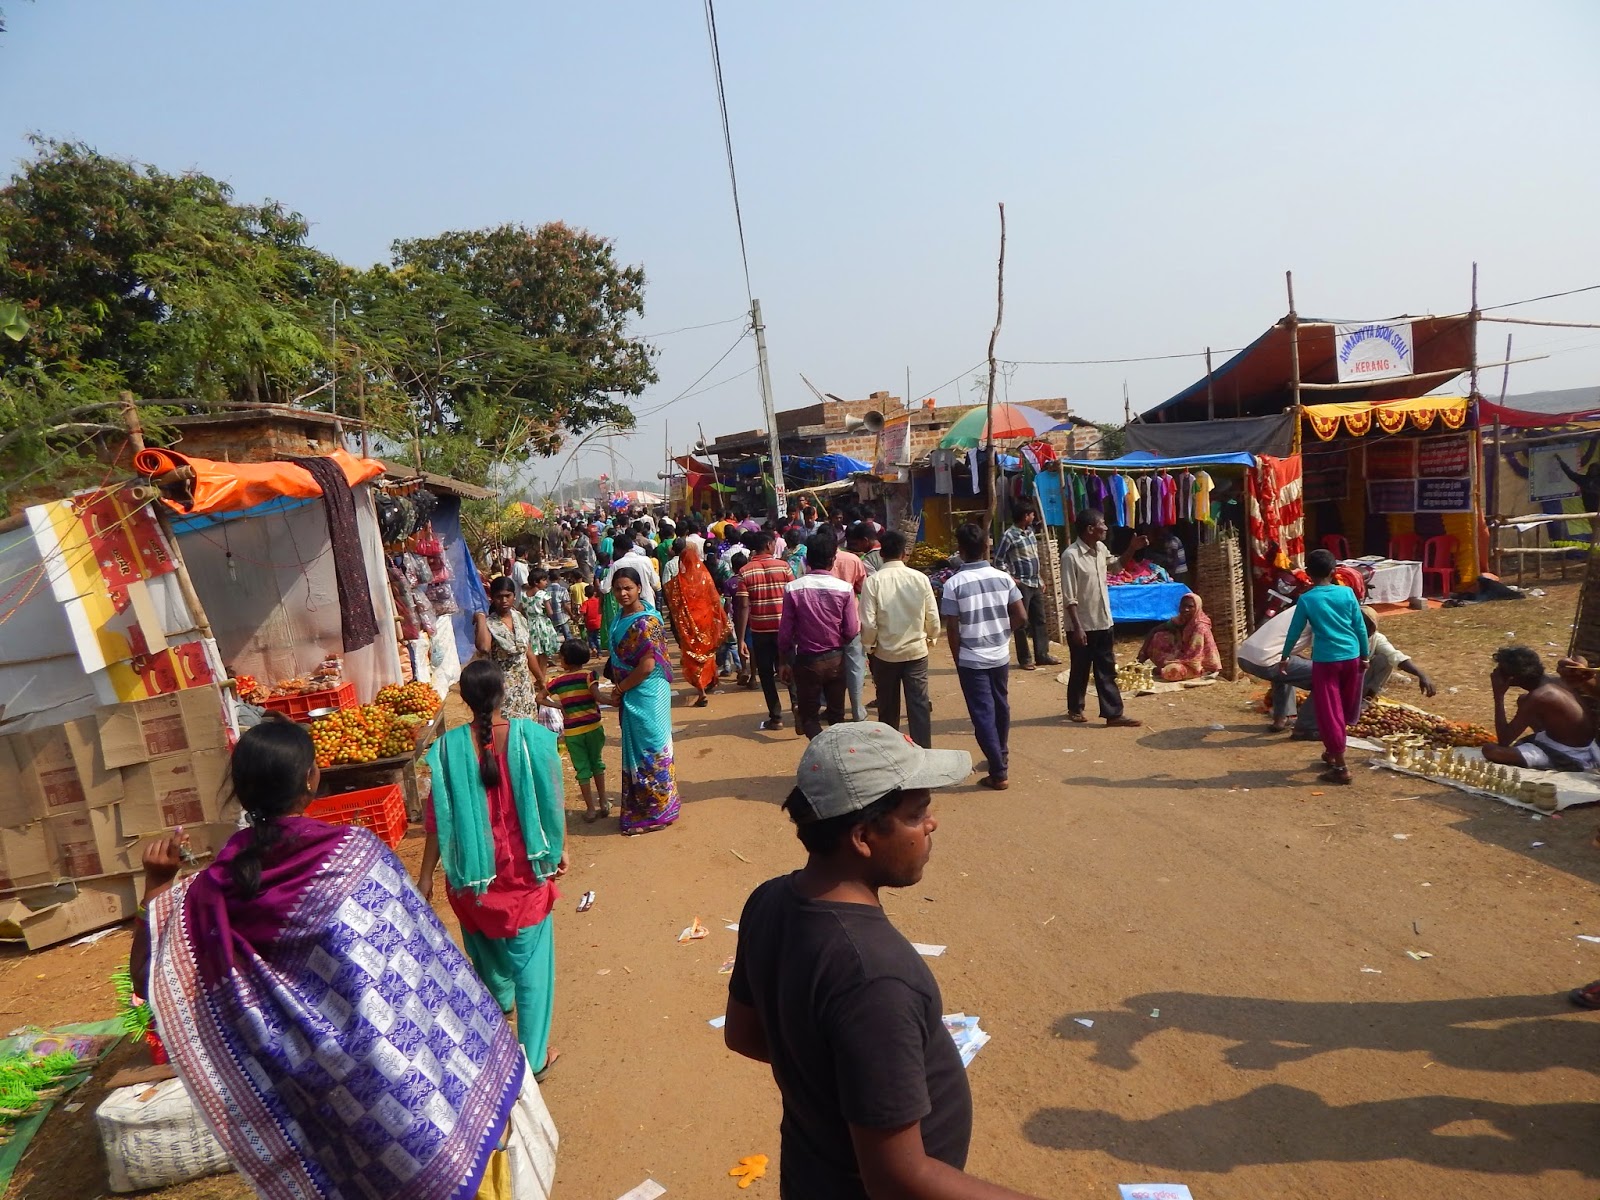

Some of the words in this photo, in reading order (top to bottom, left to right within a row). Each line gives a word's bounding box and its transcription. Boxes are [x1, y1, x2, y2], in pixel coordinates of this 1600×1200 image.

[1375, 324, 1395, 342] BOOK
[1391, 333, 1409, 360] STALL
[1355, 359, 1390, 373] KERANG
